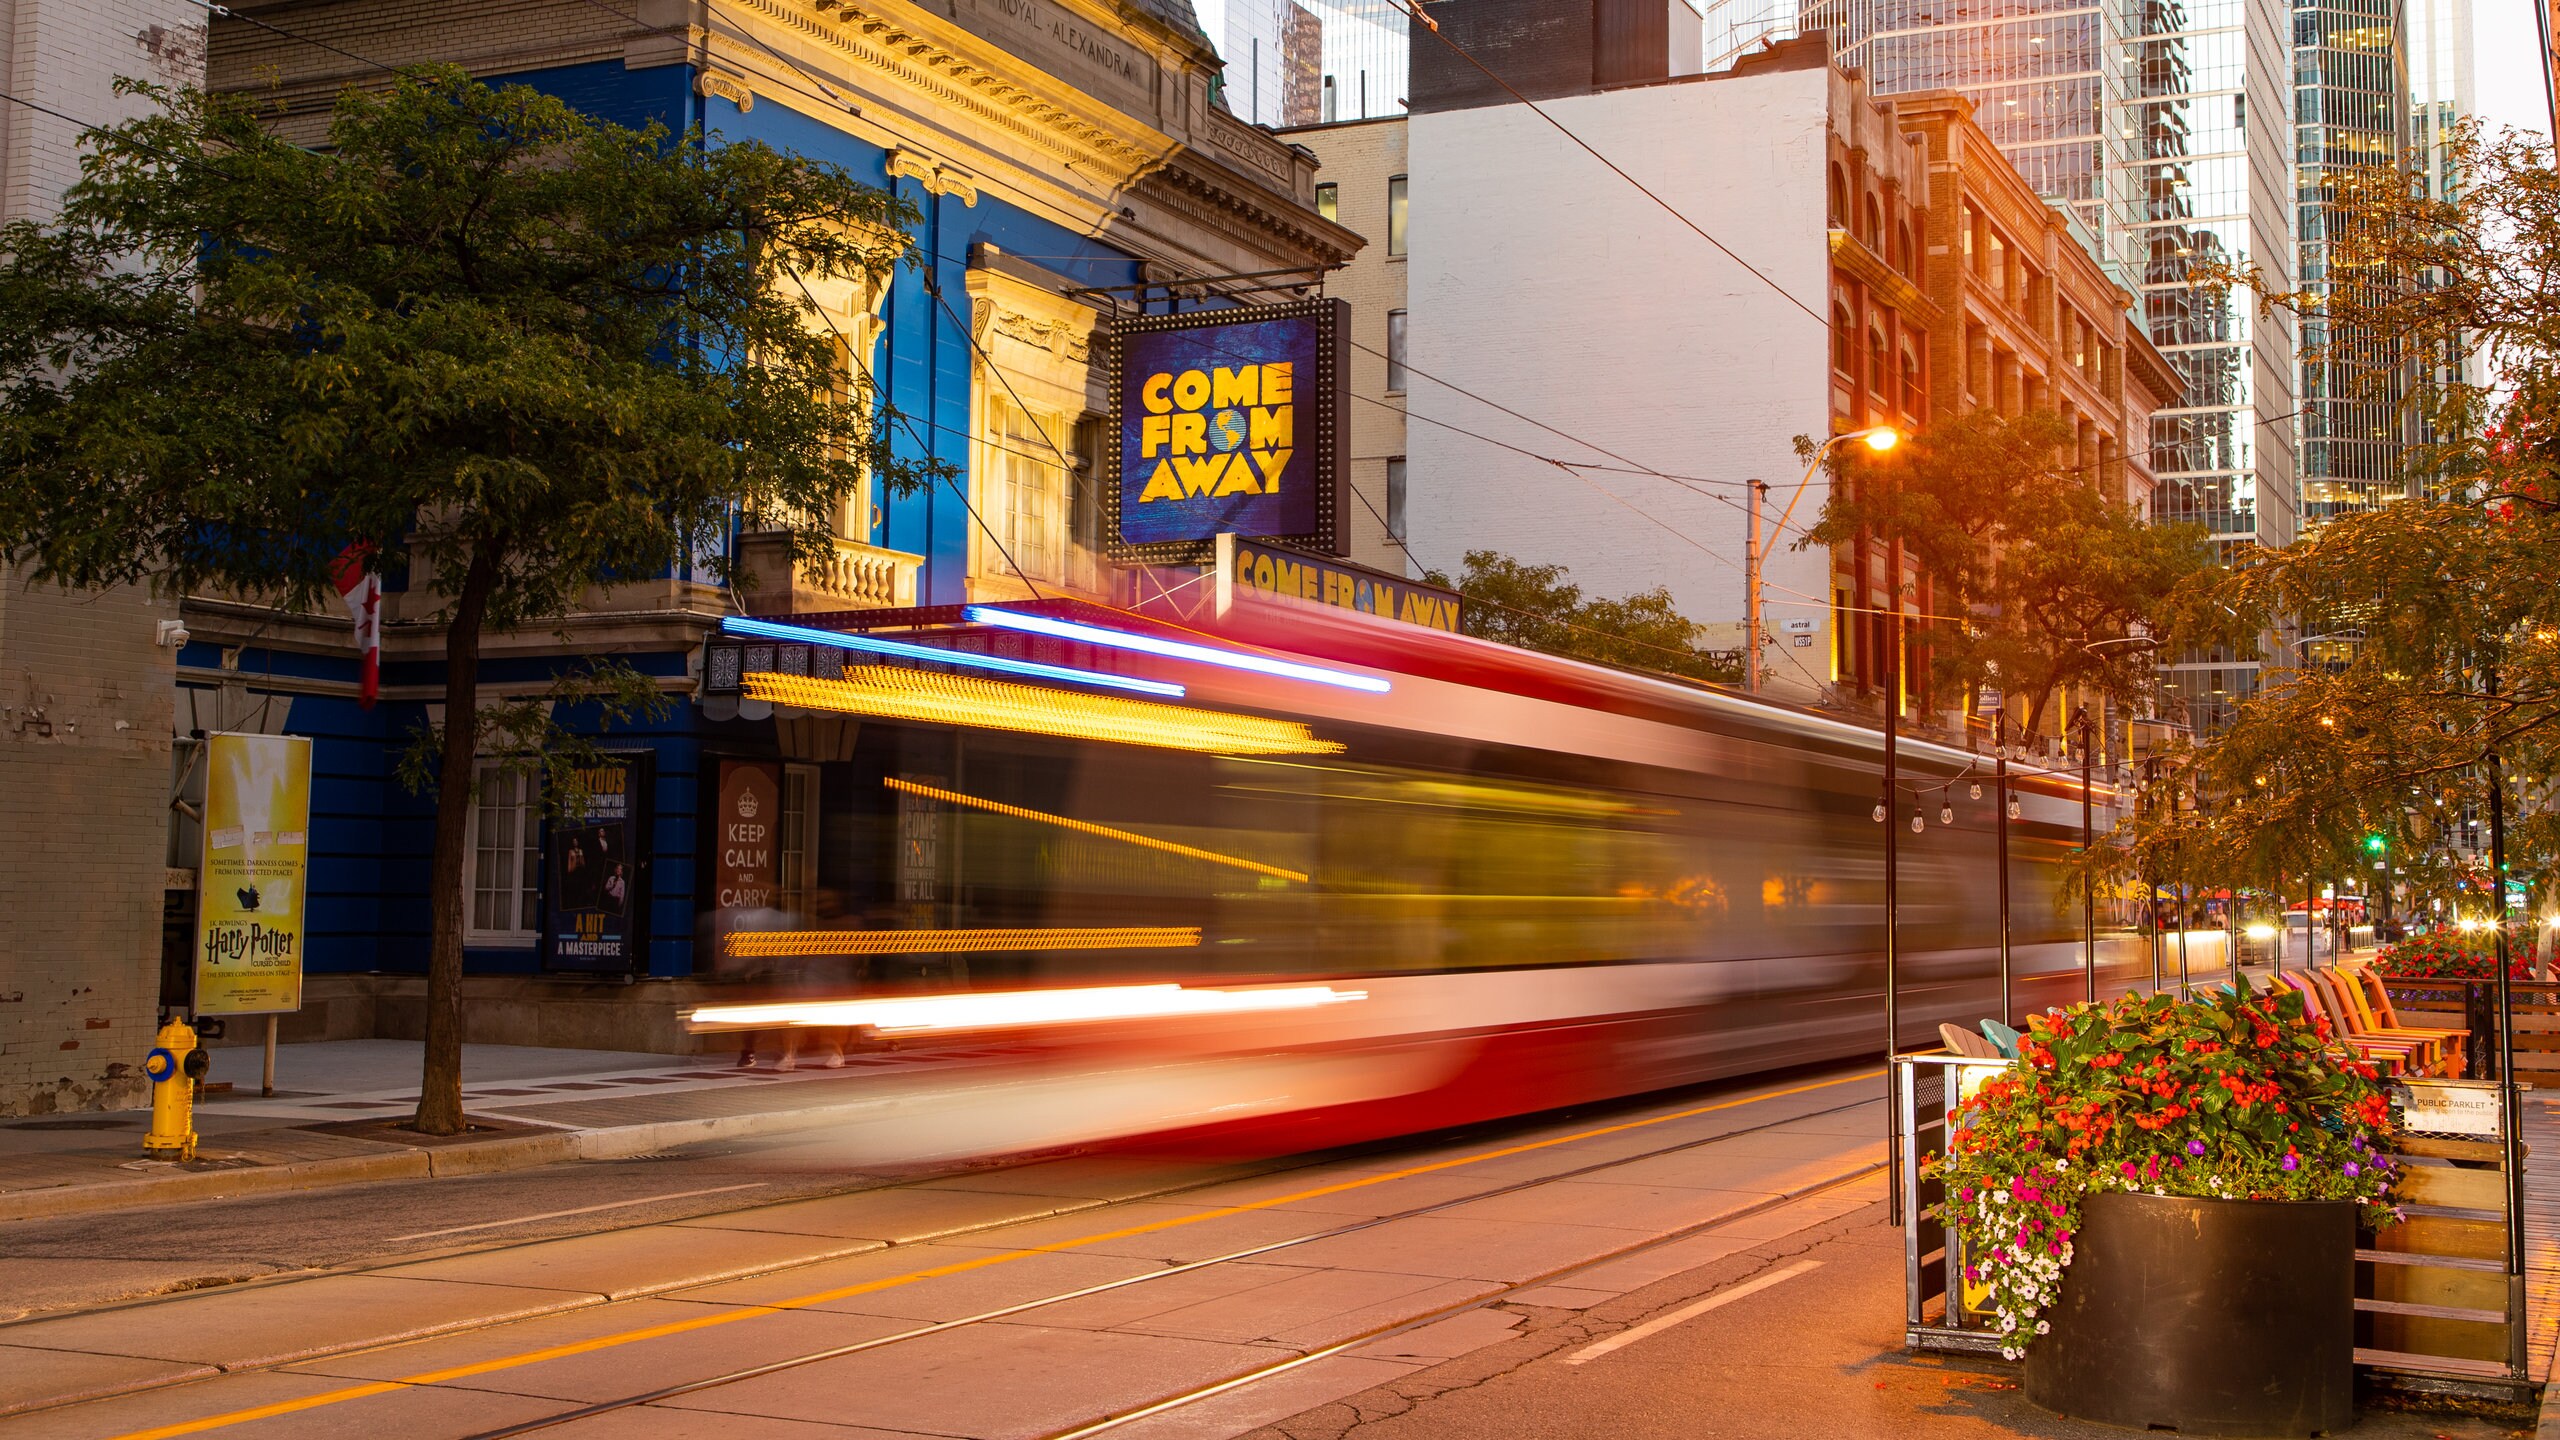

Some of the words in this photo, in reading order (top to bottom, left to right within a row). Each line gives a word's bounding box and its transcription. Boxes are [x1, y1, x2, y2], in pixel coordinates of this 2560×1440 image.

[998, 0, 1042, 31] ROYAL
[1052, 21, 1132, 81] ALEXANDRA
[1142, 361, 1293, 414] COME
[1138, 448, 1294, 503] AWAY
[1237, 549, 1318, 602] COME
[1400, 590, 1461, 633] AWAY
[1790, 621, 1810, 629] astral
[570, 767, 627, 794] OYOUS
[728, 823, 765, 843] KEEP
[905, 811, 937, 840] COME
[247, 859, 277, 867] DARKNESS
[725, 849, 767, 868] CALM
[904, 840, 936, 868] FROM
[215, 868, 233, 876] FROM
[234, 868, 272, 876] UNEXPECTED
[738, 873, 754, 883] AND
[720, 888, 770, 908] CARRY
[904, 880, 917, 901] WE
[918, 880, 935, 901] ALL
[575, 912, 583, 934] A
[585, 912, 606, 933] HIT
[205, 927, 249, 965] Harry
[251, 922, 294, 962] Potter
[581, 933, 598, 941] AND
[557, 941, 564, 955] A
[2417, 1098, 2447, 1107] PUBLIC
[2448, 1100, 2486, 1109] PARKLET
